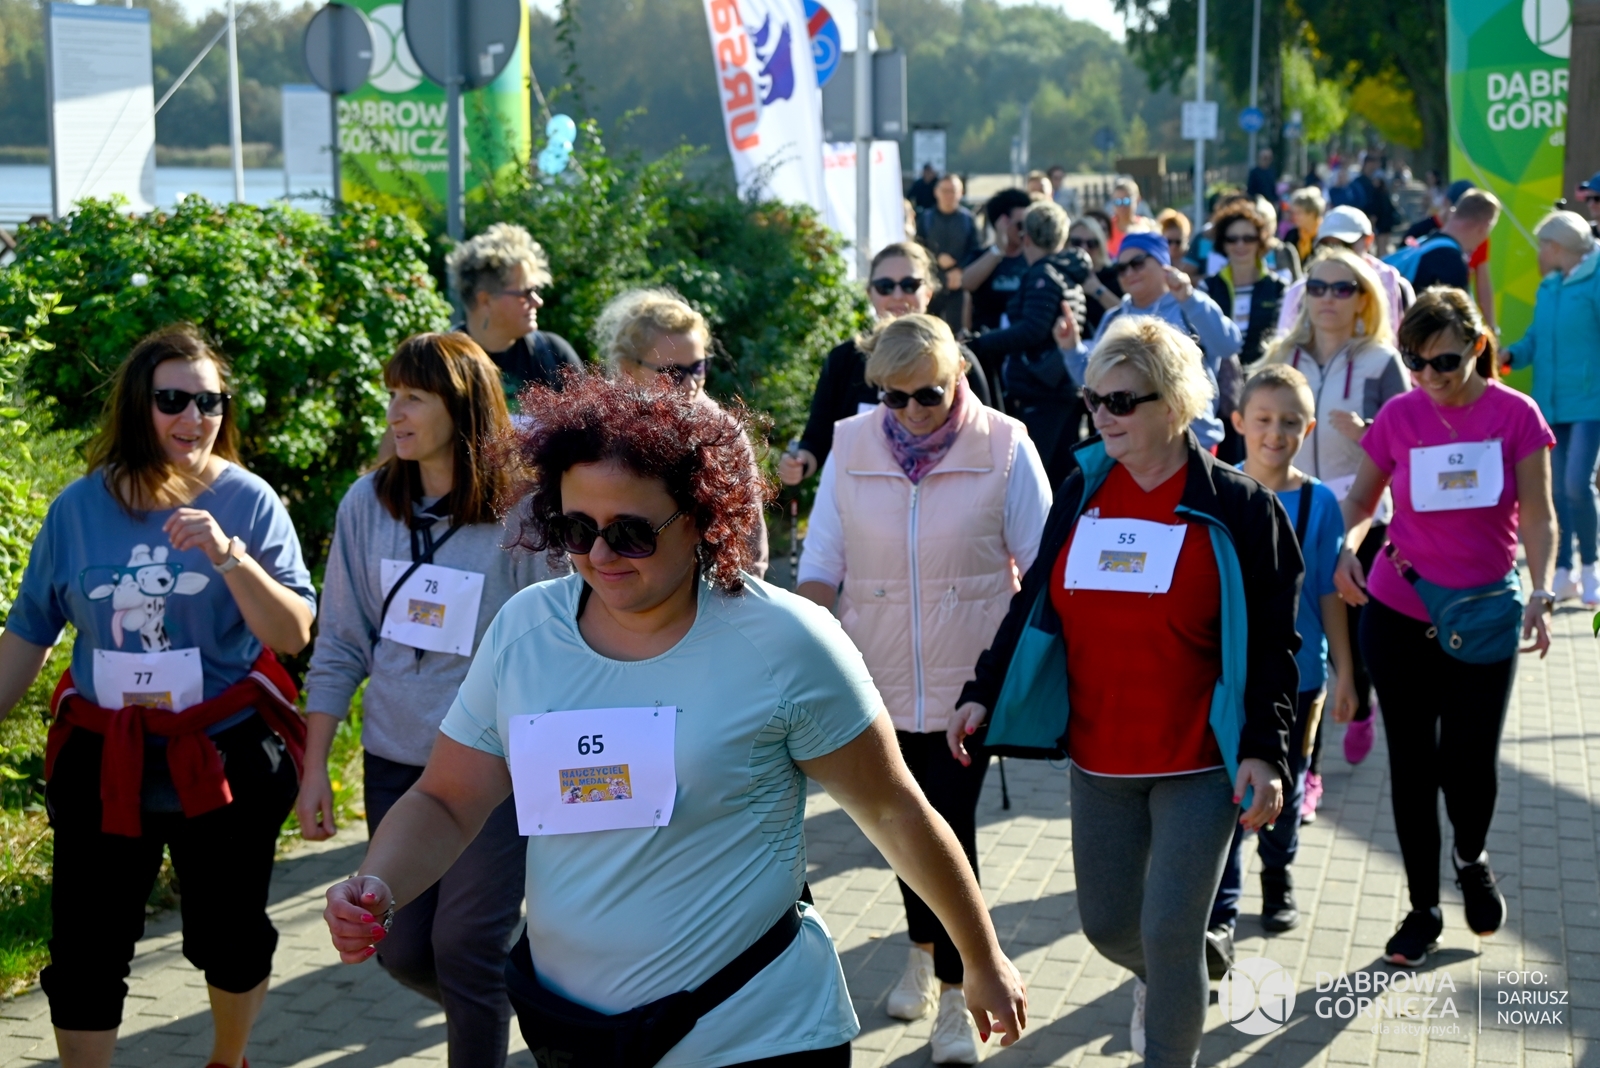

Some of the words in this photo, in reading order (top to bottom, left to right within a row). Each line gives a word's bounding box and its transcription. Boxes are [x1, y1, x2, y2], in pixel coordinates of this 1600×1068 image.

[1448, 453, 1464, 465] 62
[1117, 532, 1137, 545] 55
[424, 579, 438, 595] 78
[134, 672, 153, 685] 77
[578, 734, 604, 755] 65
[562, 766, 624, 778] NAUCZYCIEL
[579, 778, 607, 786] MEDAL
